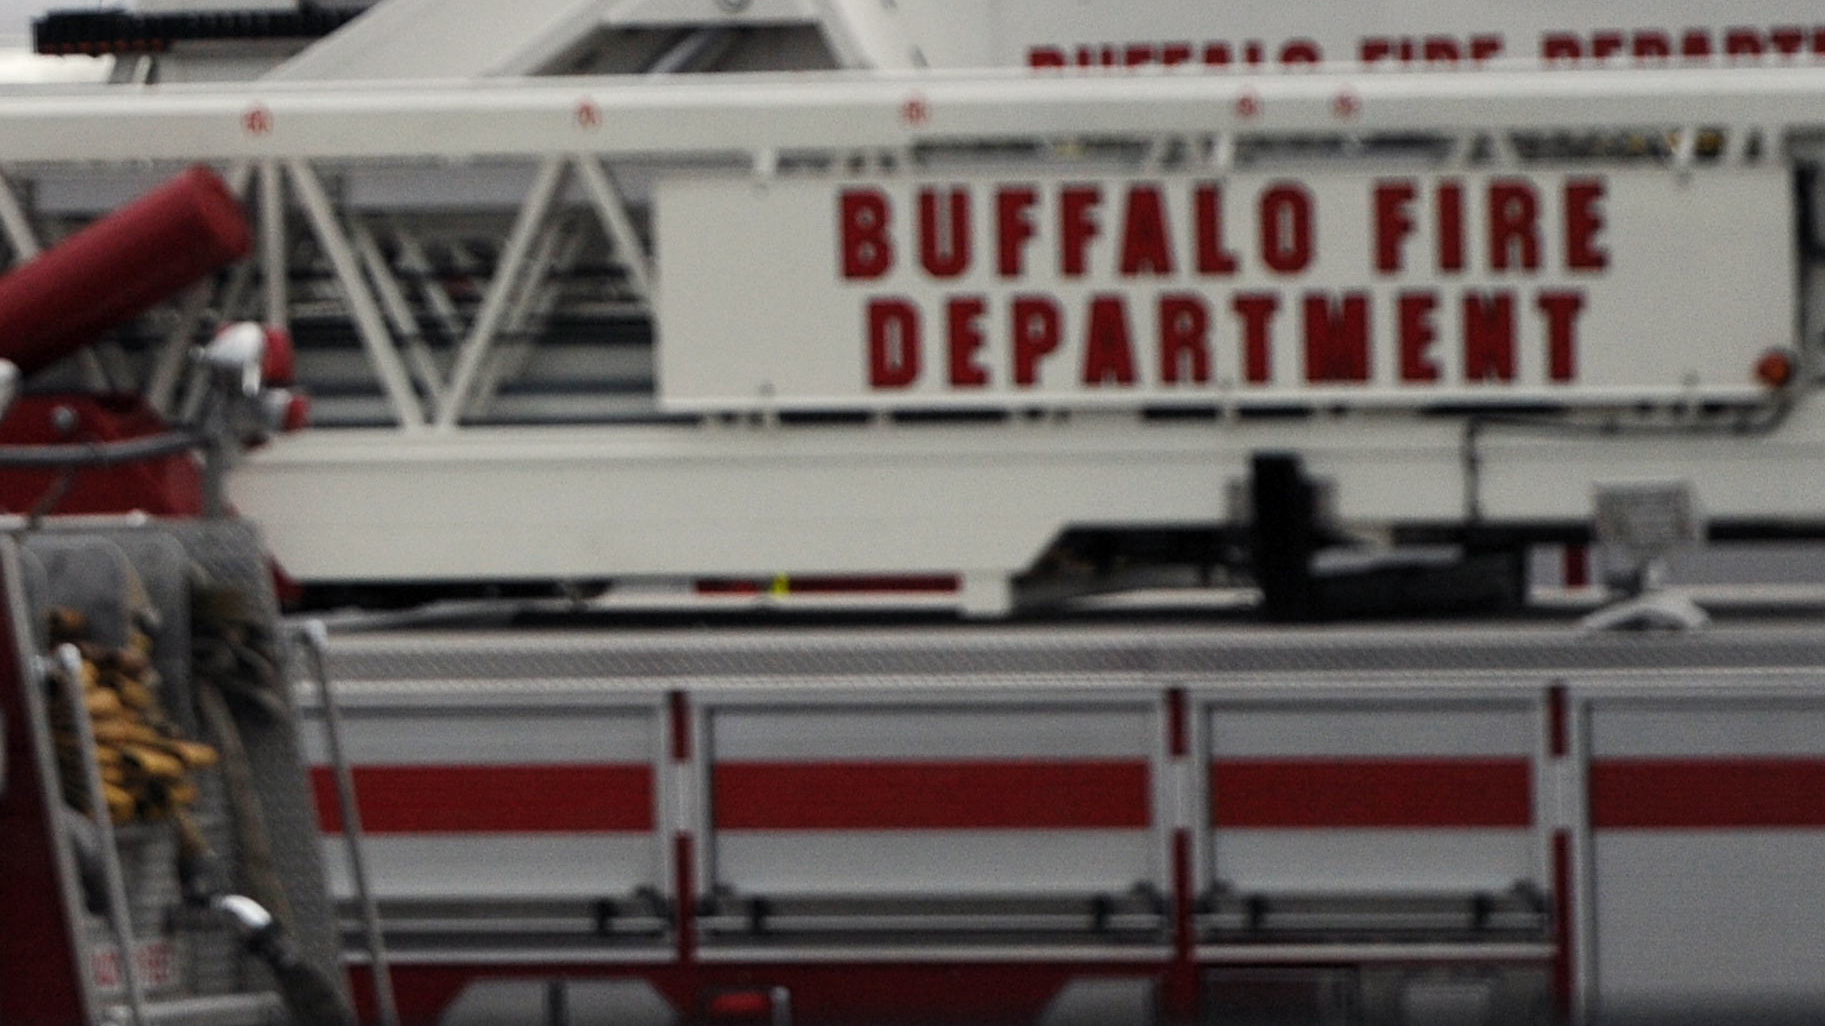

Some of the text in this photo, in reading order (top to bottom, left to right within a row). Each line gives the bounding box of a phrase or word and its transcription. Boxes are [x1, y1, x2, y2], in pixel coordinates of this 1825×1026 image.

[839, 180, 1609, 281] BUFFALO FIRE
[866, 290, 1584, 390] DEPARTMENT
